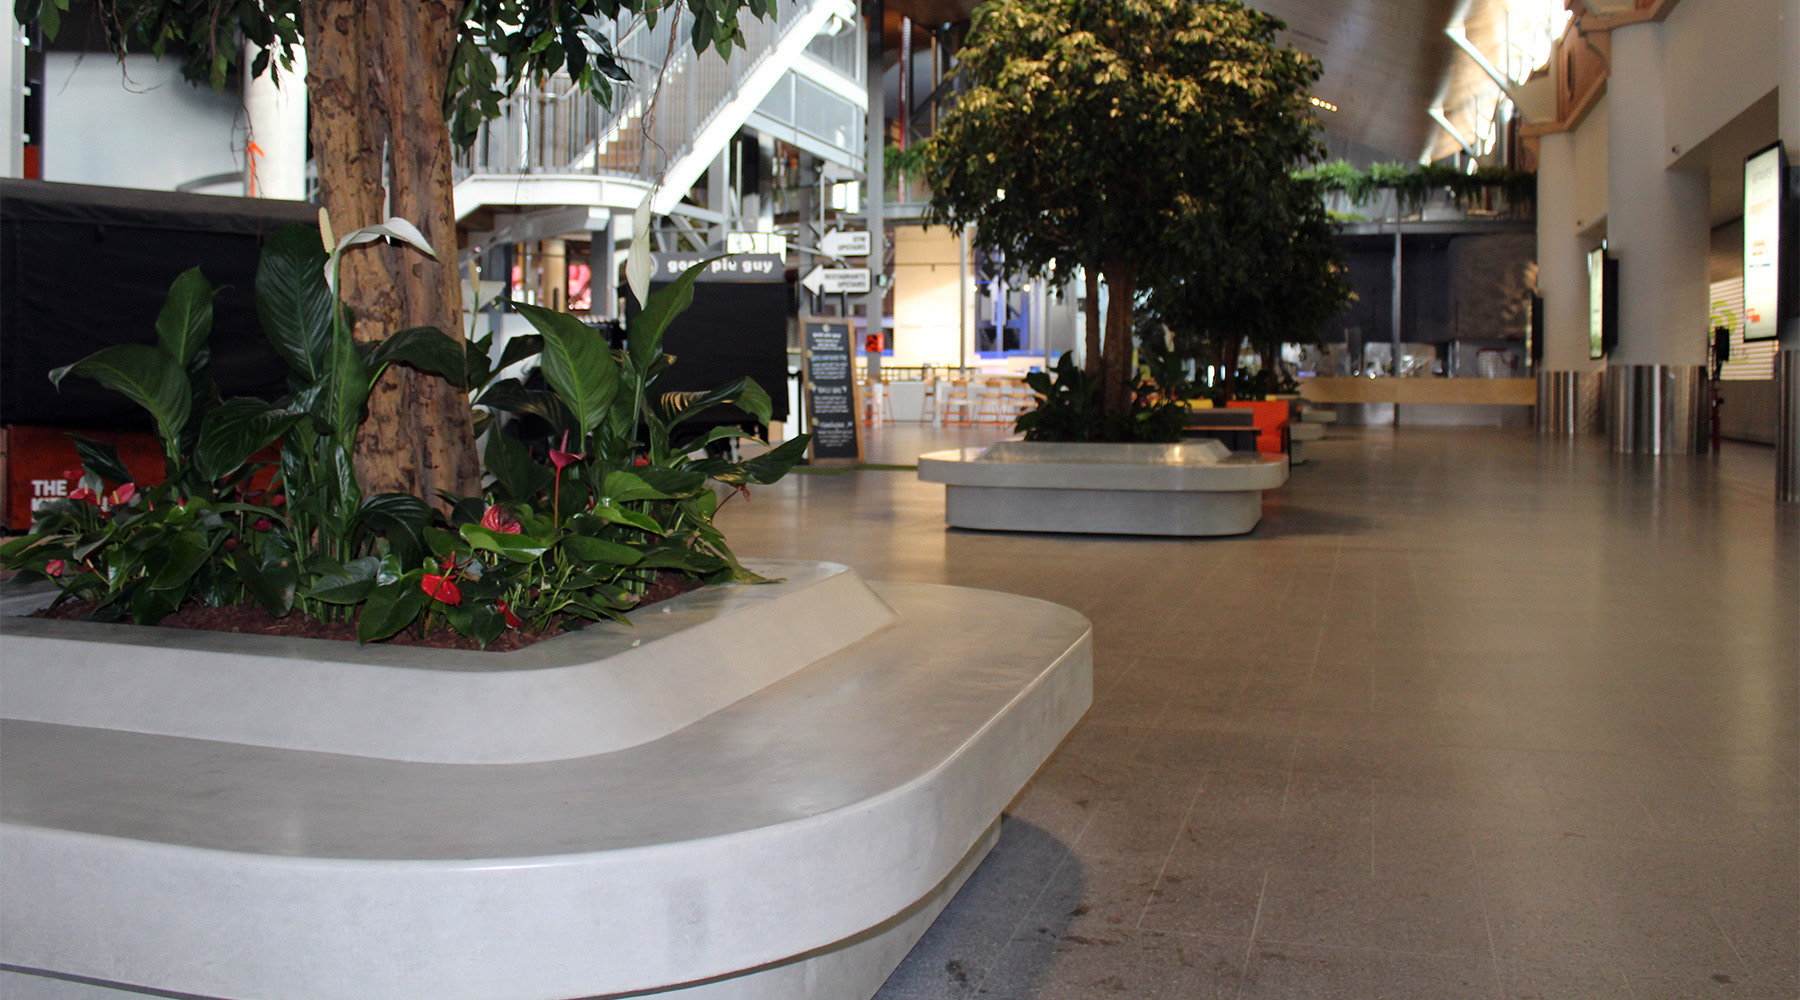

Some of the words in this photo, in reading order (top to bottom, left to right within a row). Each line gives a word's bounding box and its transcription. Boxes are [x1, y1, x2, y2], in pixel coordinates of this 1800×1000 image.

[667, 258, 707, 273] go
[711, 258, 737, 274] pie
[742, 260, 773, 274] guy
[31, 479, 68, 497] THE
